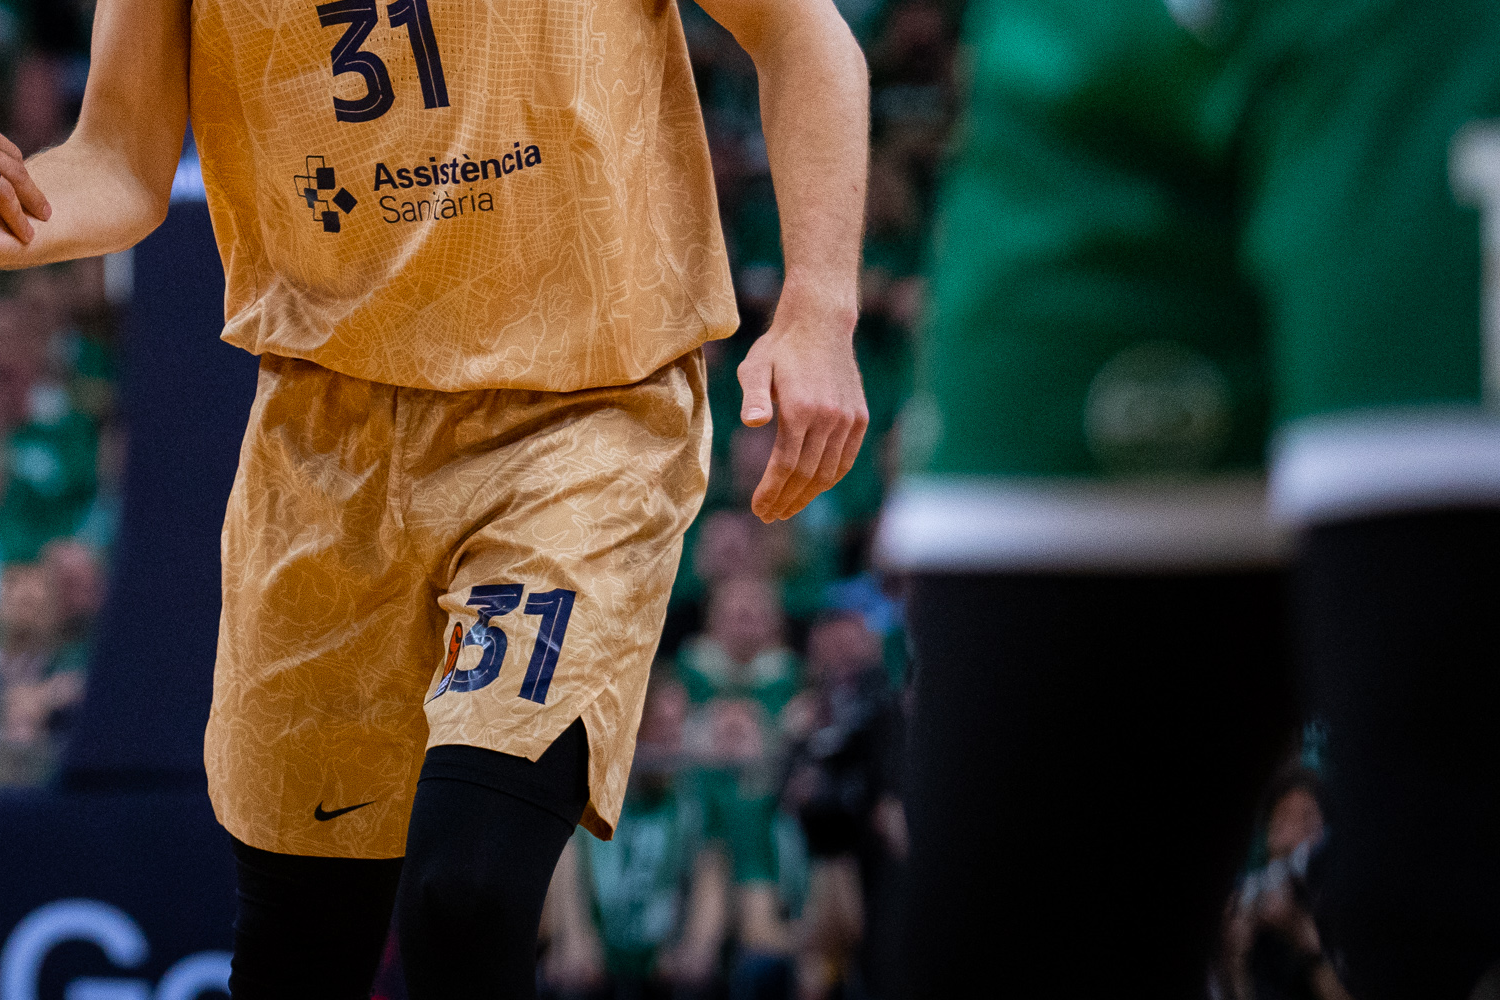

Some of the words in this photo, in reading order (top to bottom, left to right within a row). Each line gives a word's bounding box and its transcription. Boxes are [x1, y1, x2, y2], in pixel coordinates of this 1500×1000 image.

[373, 141, 542, 192] Assistència
[379, 186, 495, 225] Sanitària
[447, 583, 577, 706] 31
